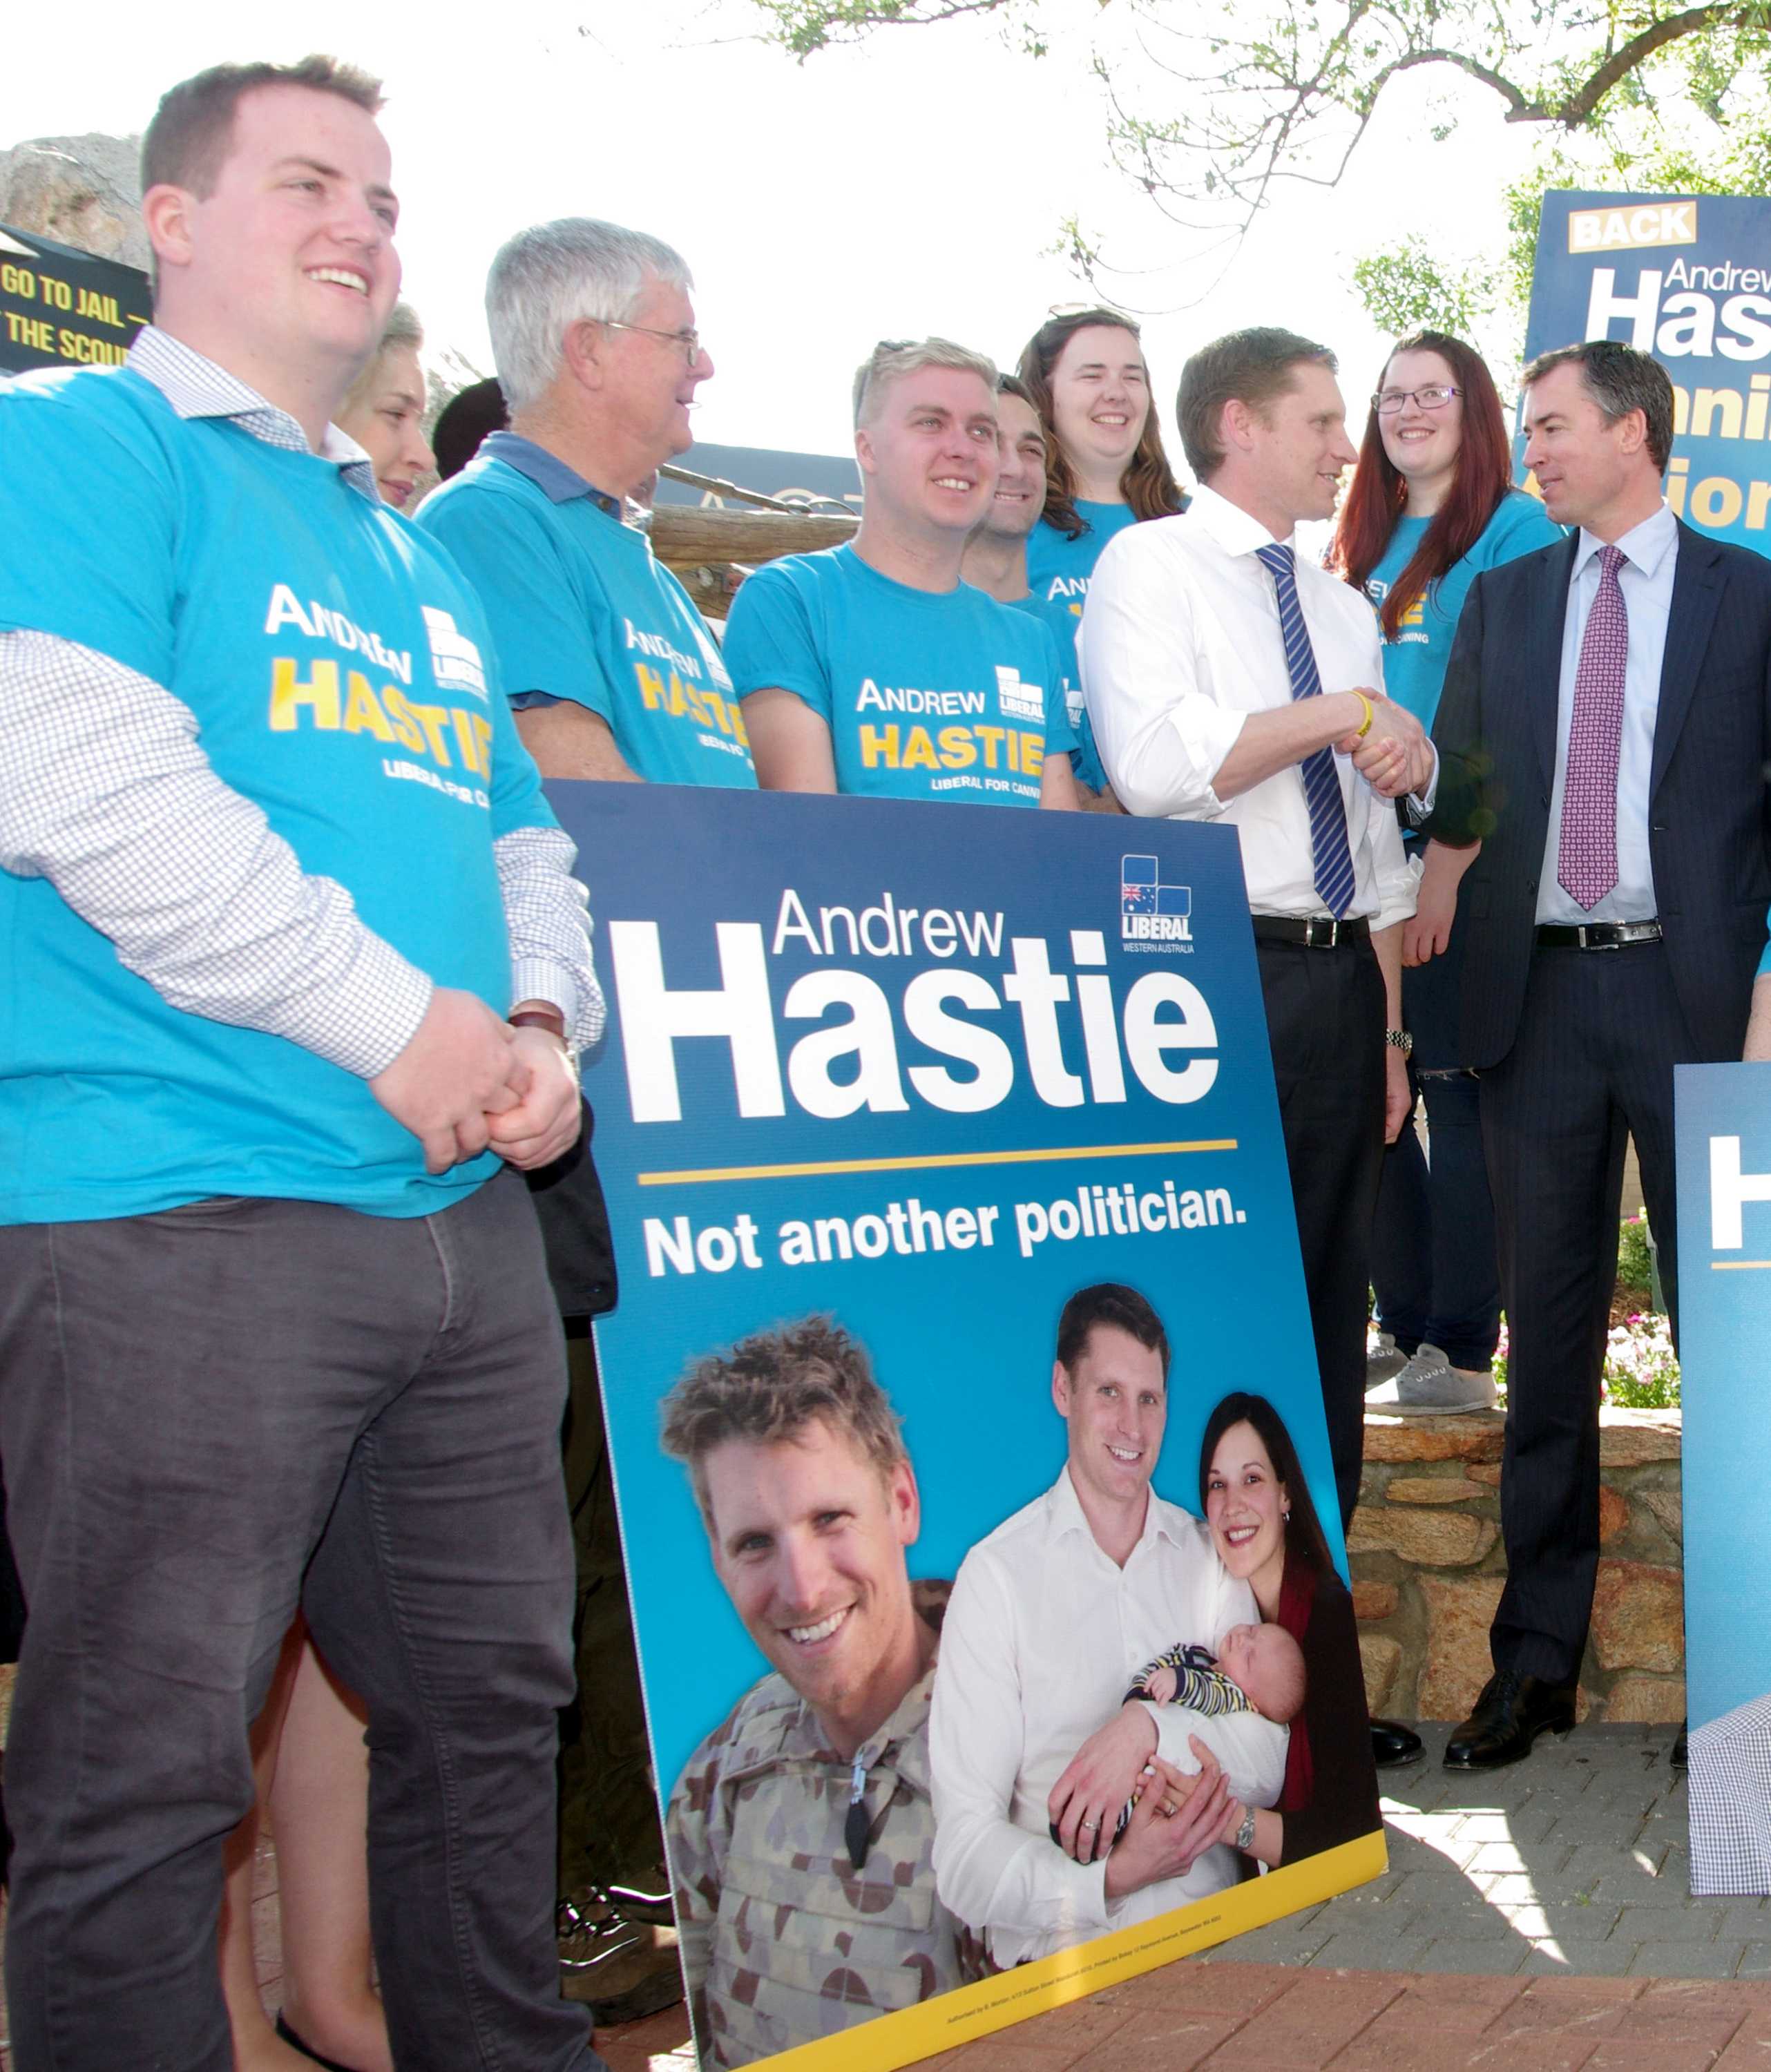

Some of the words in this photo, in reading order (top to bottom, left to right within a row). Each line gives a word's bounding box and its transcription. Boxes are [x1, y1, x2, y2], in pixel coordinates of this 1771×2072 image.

[1573, 207, 1692, 247] BACK
[1, 263, 35, 299] GO
[39, 275, 73, 311] TO
[75, 287, 126, 329] JAIL
[6, 311, 56, 354] THE
[265, 584, 412, 684] ANDREW
[856, 678, 986, 716] ANDREW
[859, 724, 1045, 777] HASTIE
[931, 775, 983, 791] LIBERAL
[986, 778, 1011, 792] FOR
[772, 889, 1004, 958] Andrew
[1122, 916, 1194, 941] LIBERAL
[1122, 943, 1158, 953] WESTERN
[1158, 944, 1195, 954] AUSTRALIA
[609, 921, 1220, 1123] Hastie
[643, 1207, 763, 1277] Not
[779, 1198, 999, 1265] another
[1015, 1180, 1247, 1258] politician.
